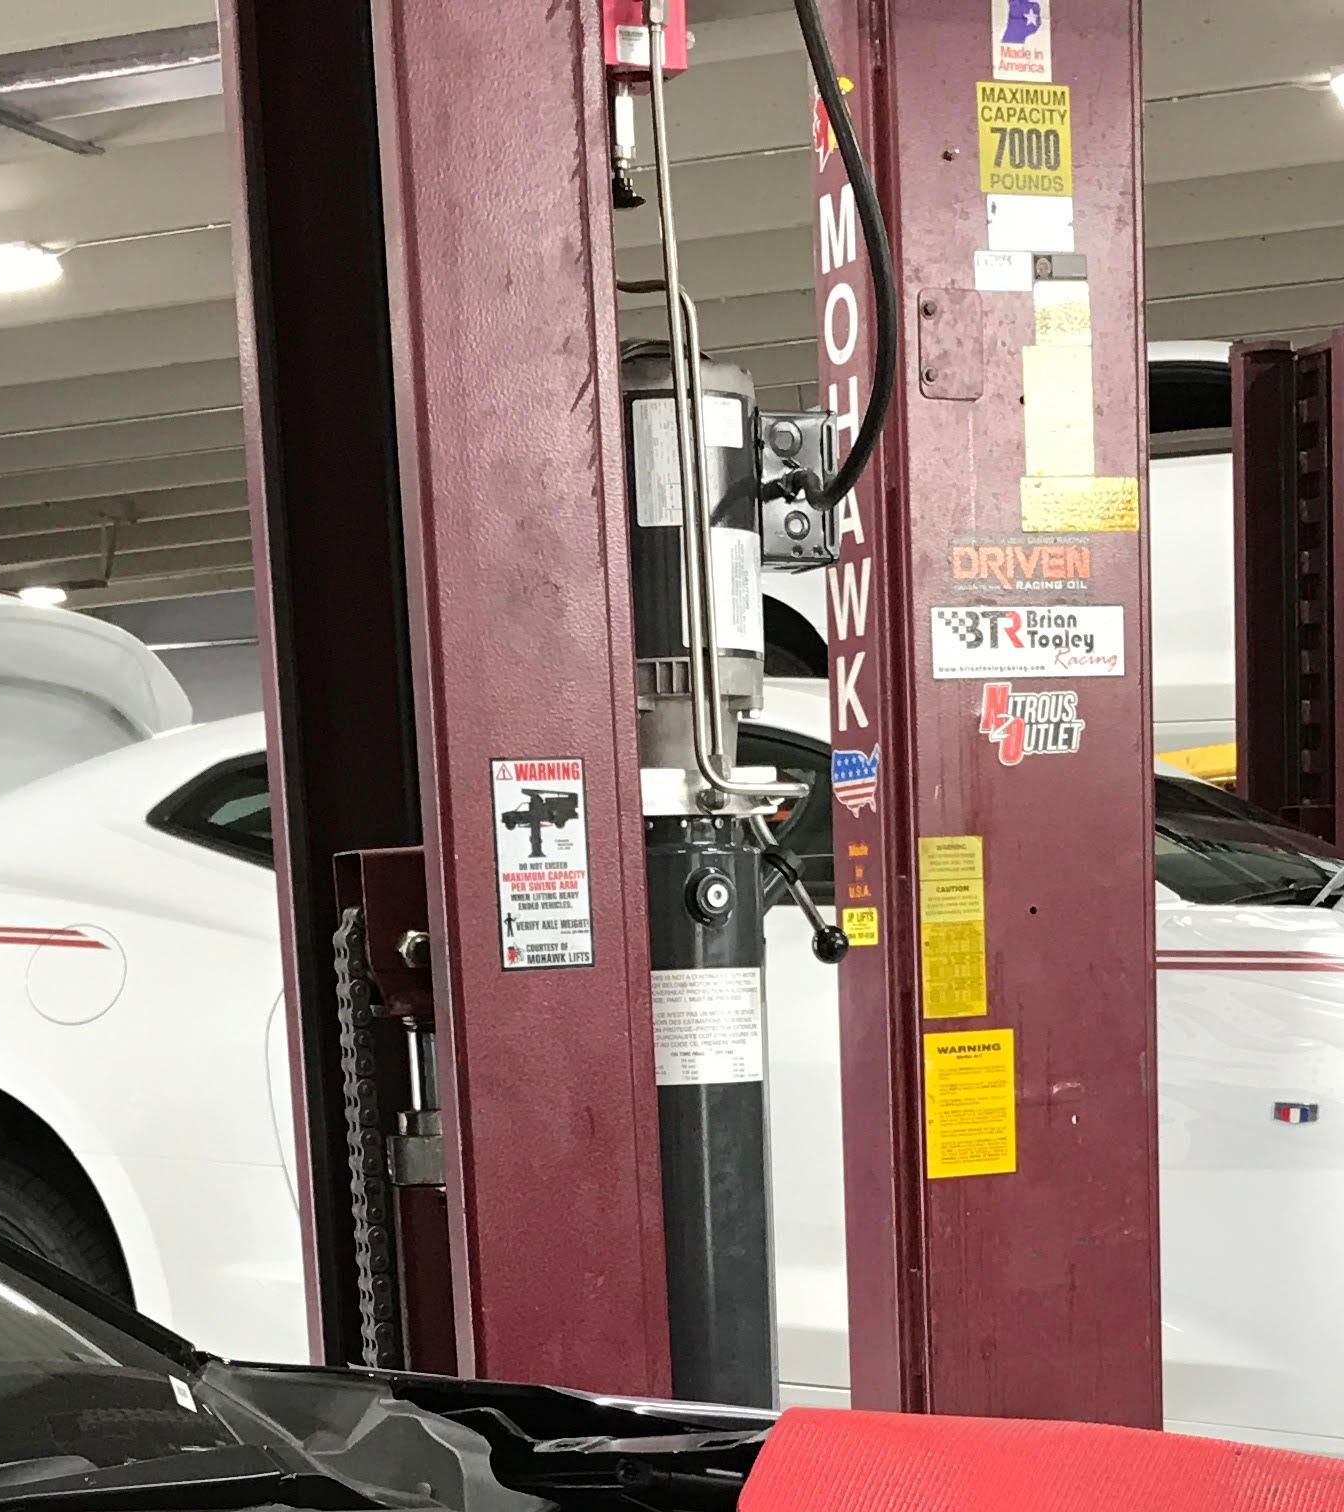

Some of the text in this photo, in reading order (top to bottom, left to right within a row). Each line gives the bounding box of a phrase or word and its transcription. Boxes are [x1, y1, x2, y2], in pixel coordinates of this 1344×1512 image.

[1000, 46, 1044, 60] Made in
[998, 60, 1045, 74] America
[981, 87, 1066, 106] MAXIMUM
[981, 106, 1067, 125] CAPACITY
[990, 127, 1061, 172] 7000
[990, 173, 1064, 192] POUNDS
[819, 183, 871, 732] MOHAWK
[952, 546, 1092, 588] DRIVEN
[1016, 581, 1063, 590] RACING
[1066, 581, 1088, 589] OIL
[1027, 611, 1077, 628] Brian
[946, 611, 1024, 649] BTR
[1027, 631, 1094, 653] Tooley
[1055, 648, 1118, 672] Racing
[981, 684, 1076, 730] NITROUS
[1002, 717, 1083, 764] OUTLET
[514, 762, 580, 781] WARNING
[503, 870, 585, 882] MAXIMUM CAPACITY
[511, 881, 578, 892] PER SWING ARM
[848, 885, 871, 898] U.S.A.
[936, 885, 970, 893] CAUTION
[511, 893, 530, 901] WHEN
[559, 892, 579, 900] HEAVY
[518, 902, 539, 910] ENDED
[847, 911, 874, 922] JP LIFTS
[516, 919, 589, 931] VERIFY AXLE WEIGHT!
[526, 942, 568, 952] COURTESY OF
[527, 952, 590, 964] MOHAWK LIFTS
[937, 1043, 1002, 1054] WARNING
